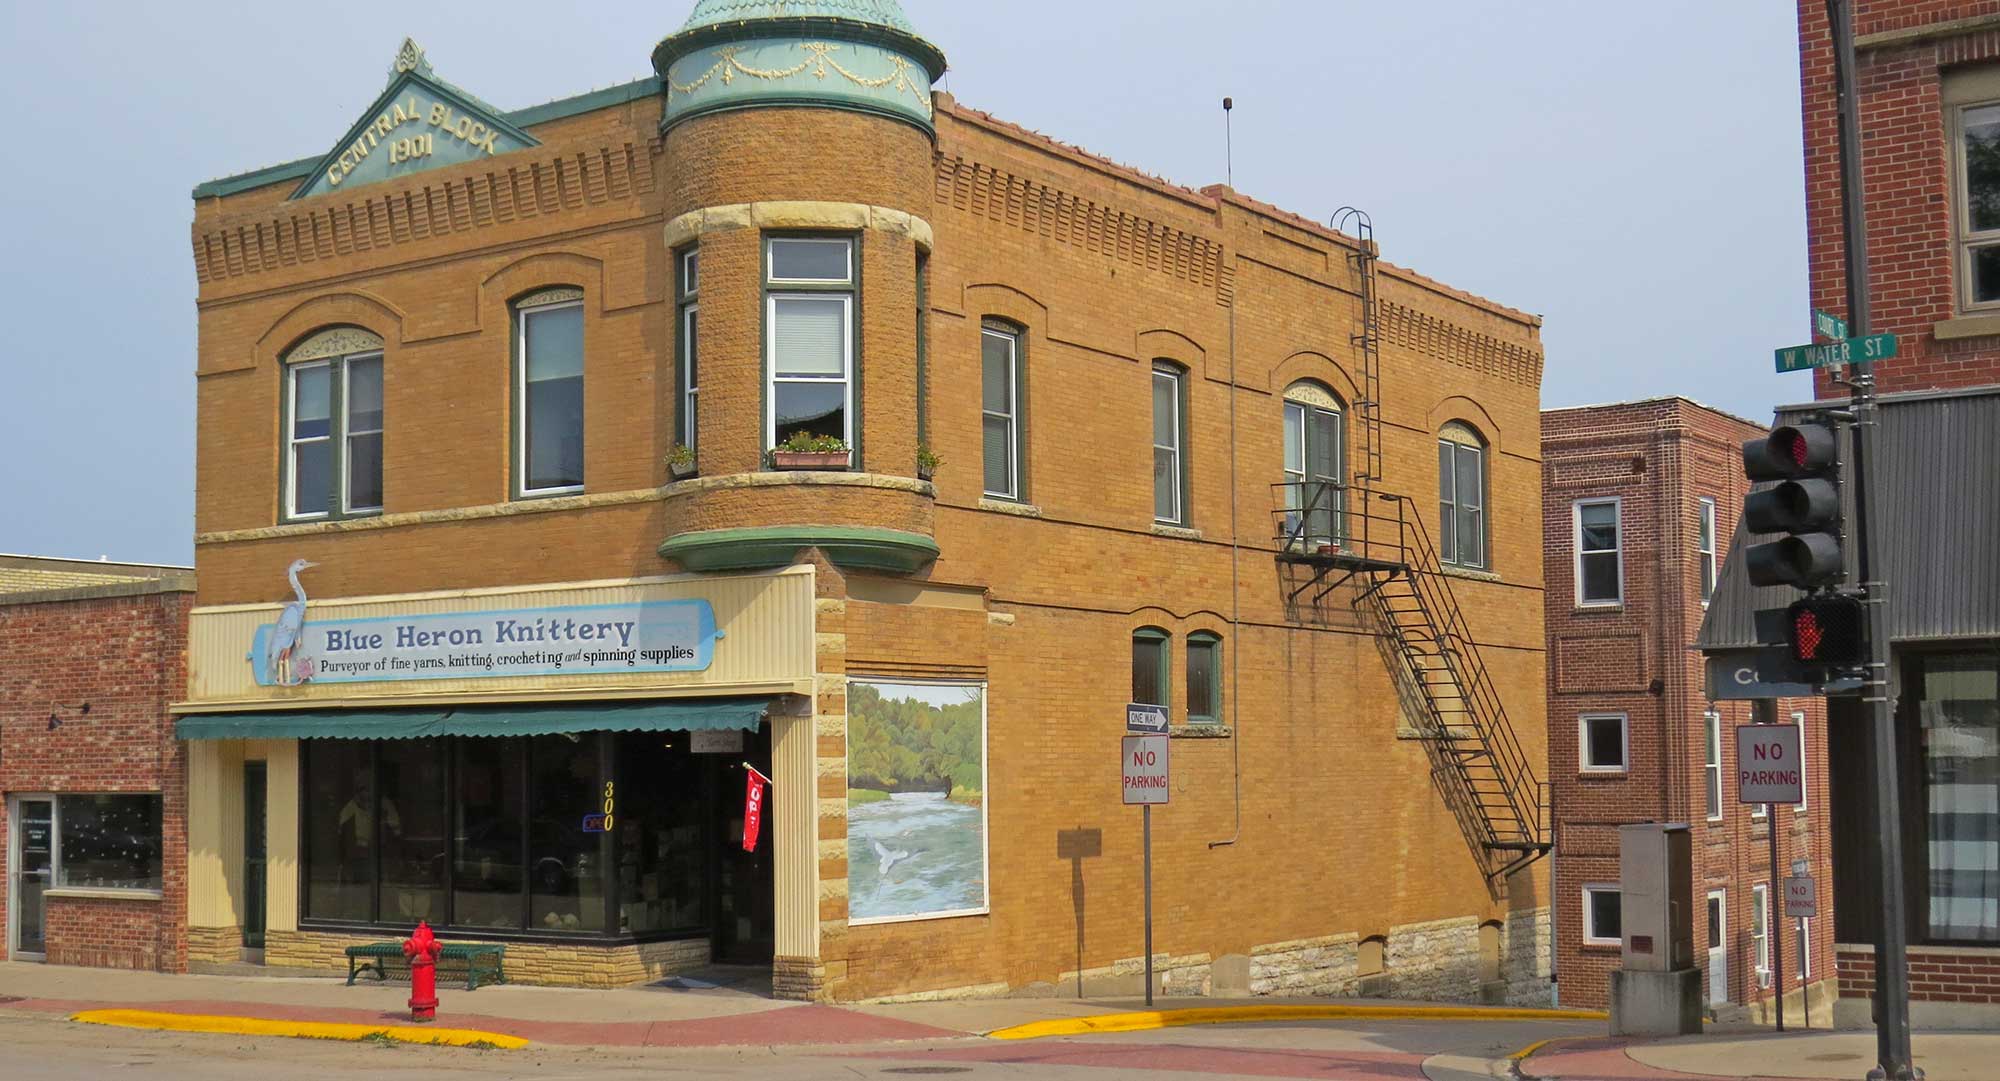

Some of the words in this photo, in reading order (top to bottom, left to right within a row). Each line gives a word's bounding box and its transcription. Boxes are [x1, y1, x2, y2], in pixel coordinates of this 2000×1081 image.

[327, 98, 421, 186] CENTRAL
[428, 103, 498, 155] BLOCK
[389, 133, 432, 165] 1901
[1783, 350, 1796, 368] W
[1804, 342, 1850, 365] WATER
[1865, 337, 1882, 357] ST
[326, 629, 382, 651] Blue
[396, 626, 483, 648] Heron
[495, 618, 635, 647] Knittery
[320, 658, 371, 675] Purveyor
[374, 657, 386, 671] of
[390, 657, 411, 670] fine
[413, 657, 446, 671] yarns,
[448, 652, 495, 670] knitting,
[496, 650, 563, 668] crocheting
[565, 649, 581, 661] and
[583, 648, 637, 667] spinning
[640, 645, 694, 664] supplies
[1131, 713, 1144, 724] ONE
[1144, 714, 1157, 725] WAY
[1134, 751, 1155, 766] NO
[1753, 743, 1783, 761] NO
[1125, 775, 1167, 788] PARKING
[1741, 771, 1798, 786] PARKING
[604, 781, 614, 832] 300
[1791, 886, 1806, 896] NO
